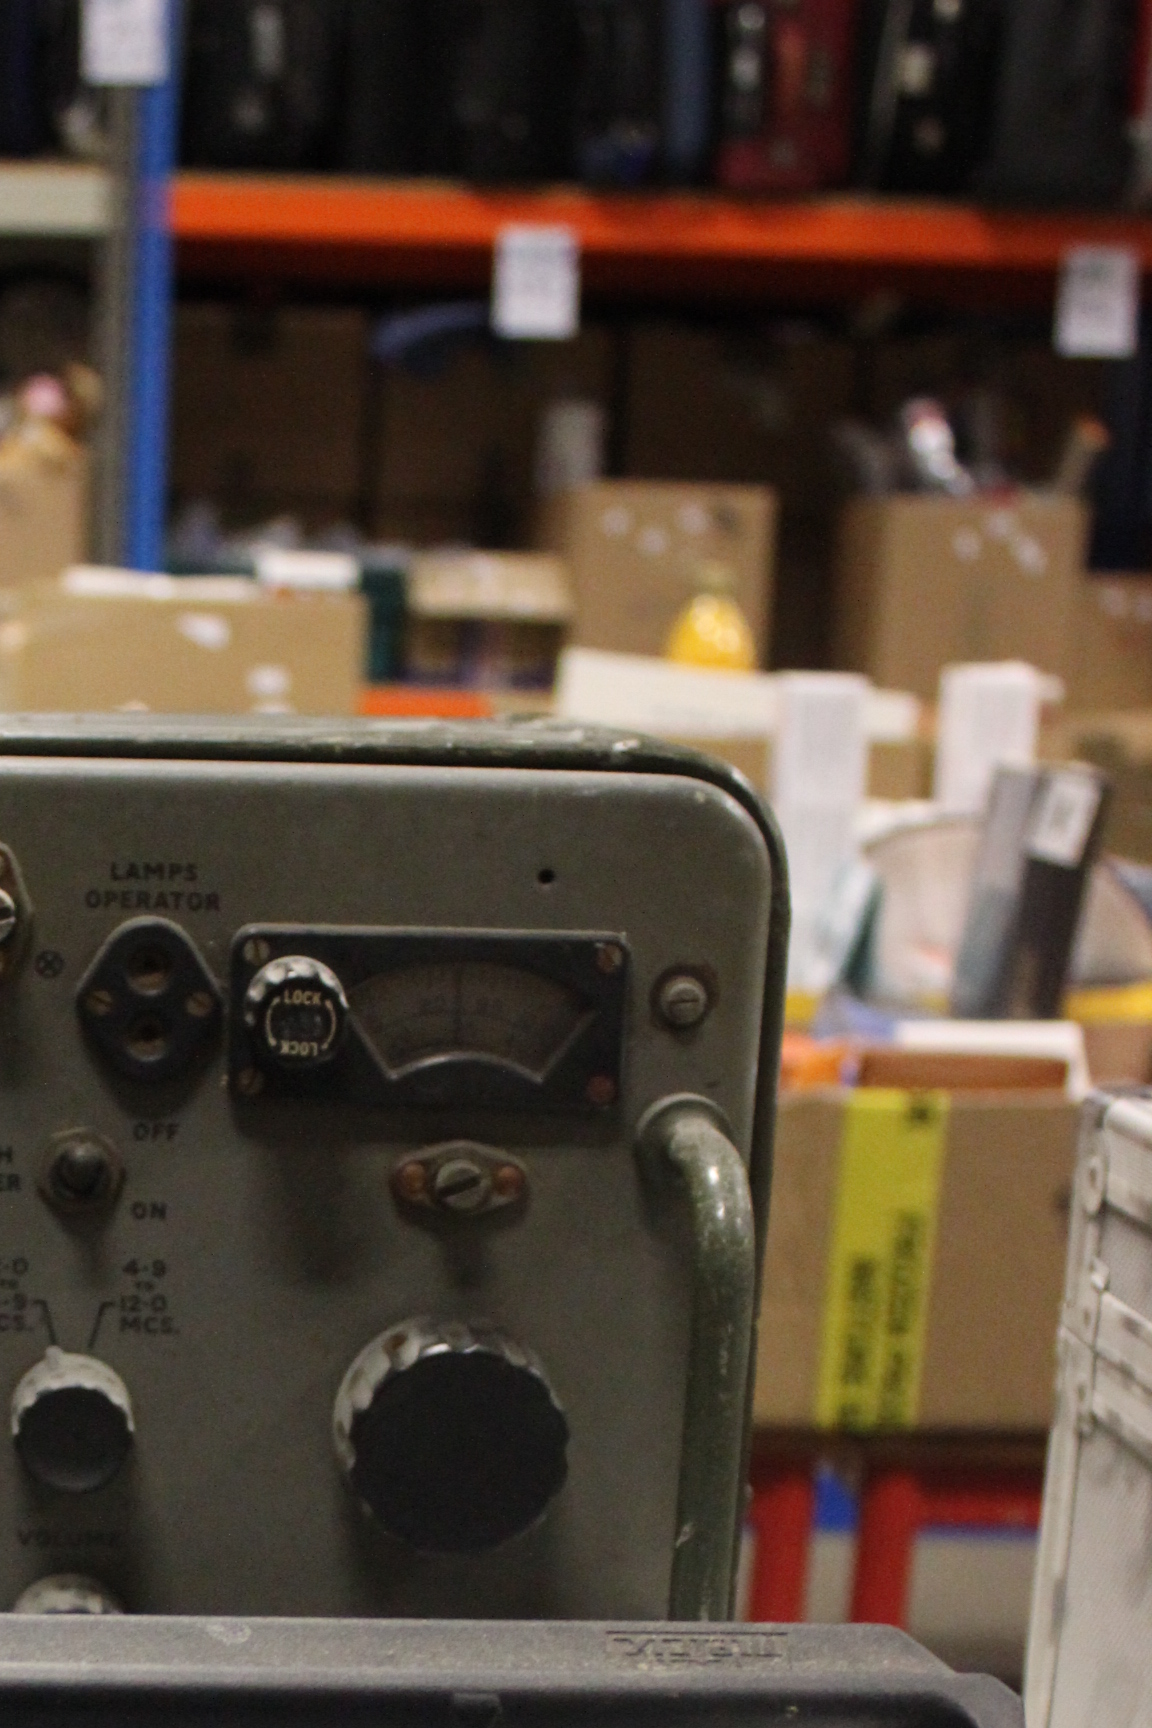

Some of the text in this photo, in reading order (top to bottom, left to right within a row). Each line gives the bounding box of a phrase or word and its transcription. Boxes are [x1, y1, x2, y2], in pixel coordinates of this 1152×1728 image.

[110, 862, 198, 881] LAMPS
[85, 890, 221, 912] OPERATOR
[283, 988, 323, 1006] LOCK
[279, 1039, 319, 1057] LOCK
[133, 1122, 180, 1142] OFF
[131, 1201, 167, 1220] ON
